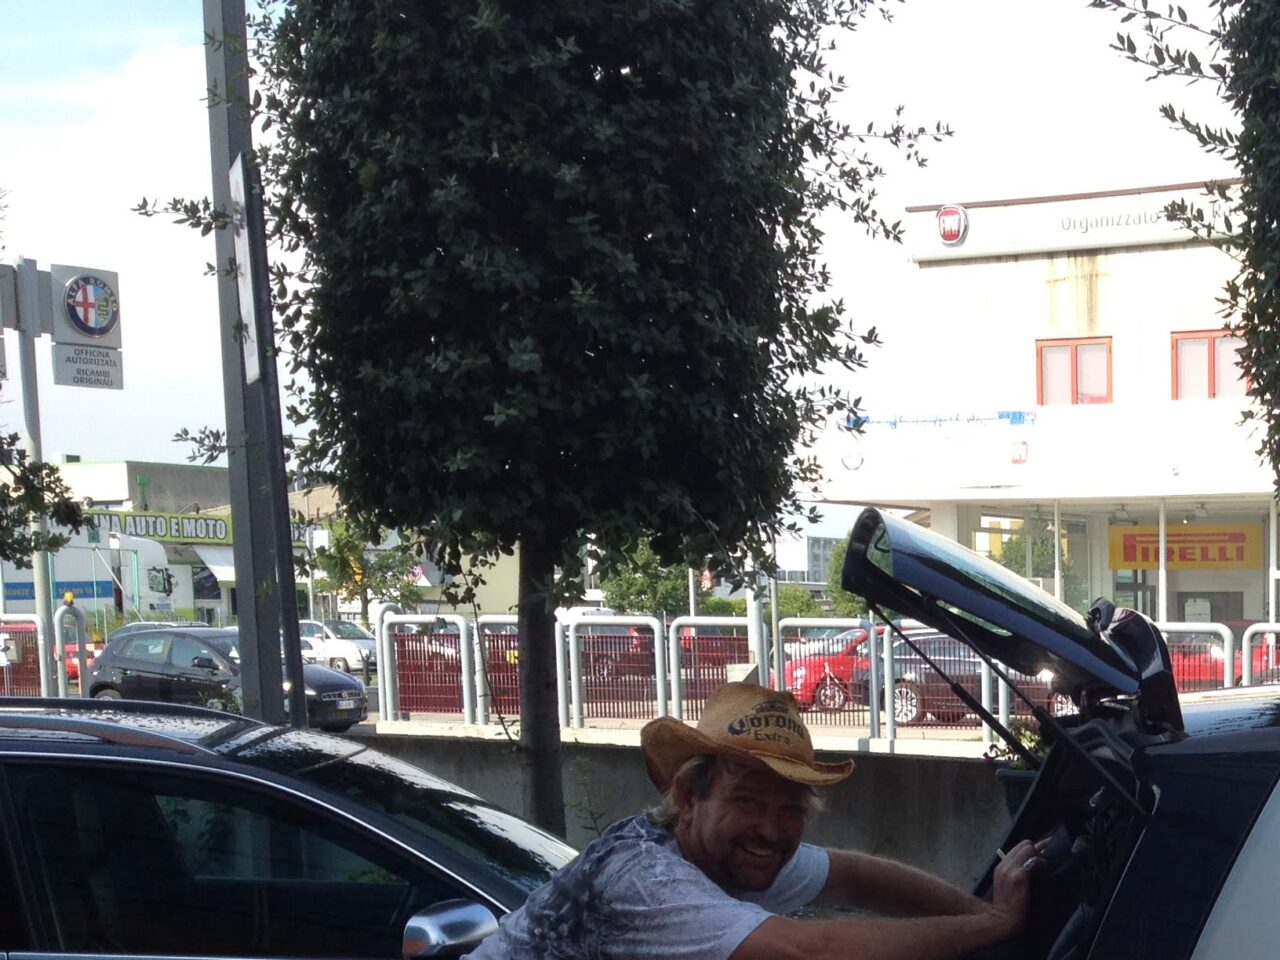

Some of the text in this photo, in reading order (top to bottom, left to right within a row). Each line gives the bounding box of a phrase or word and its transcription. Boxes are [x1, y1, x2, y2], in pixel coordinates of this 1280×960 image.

[1061, 210, 1160, 234] Organizzato
[65, 355, 118, 368] AUTORIZZATA
[74, 348, 110, 359] OFFICINA
[73, 376, 113, 386] ORIGINALI
[76, 368, 110, 378] RICAMBI
[125, 514, 167, 537] AUTO
[170, 517, 180, 538] E
[182, 517, 227, 540] MOTO
[1123, 532, 1246, 562] PIRELLI
[728, 714, 804, 739] Corona
[755, 729, 791, 745] Extra
